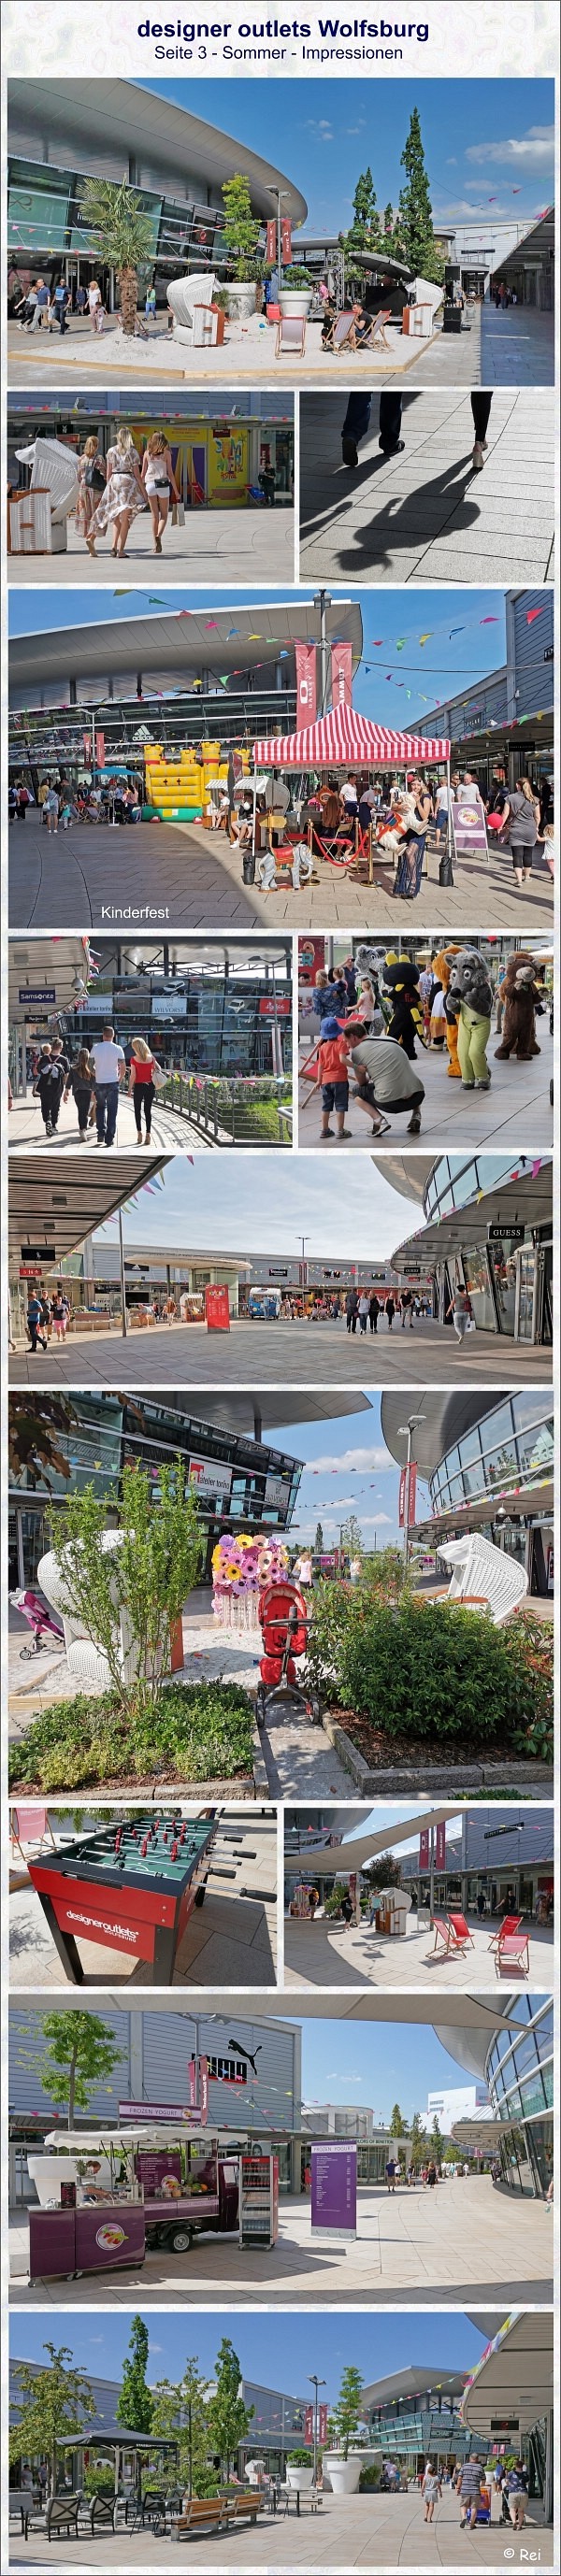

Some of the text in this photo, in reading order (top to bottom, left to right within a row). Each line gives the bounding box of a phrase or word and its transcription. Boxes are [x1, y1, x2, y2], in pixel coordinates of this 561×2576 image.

[199, 1475, 216, 1486] atelier
[104, 1929, 137, 1943] WOLFSBURG
[129, 2107, 153, 2115] FROZEN
